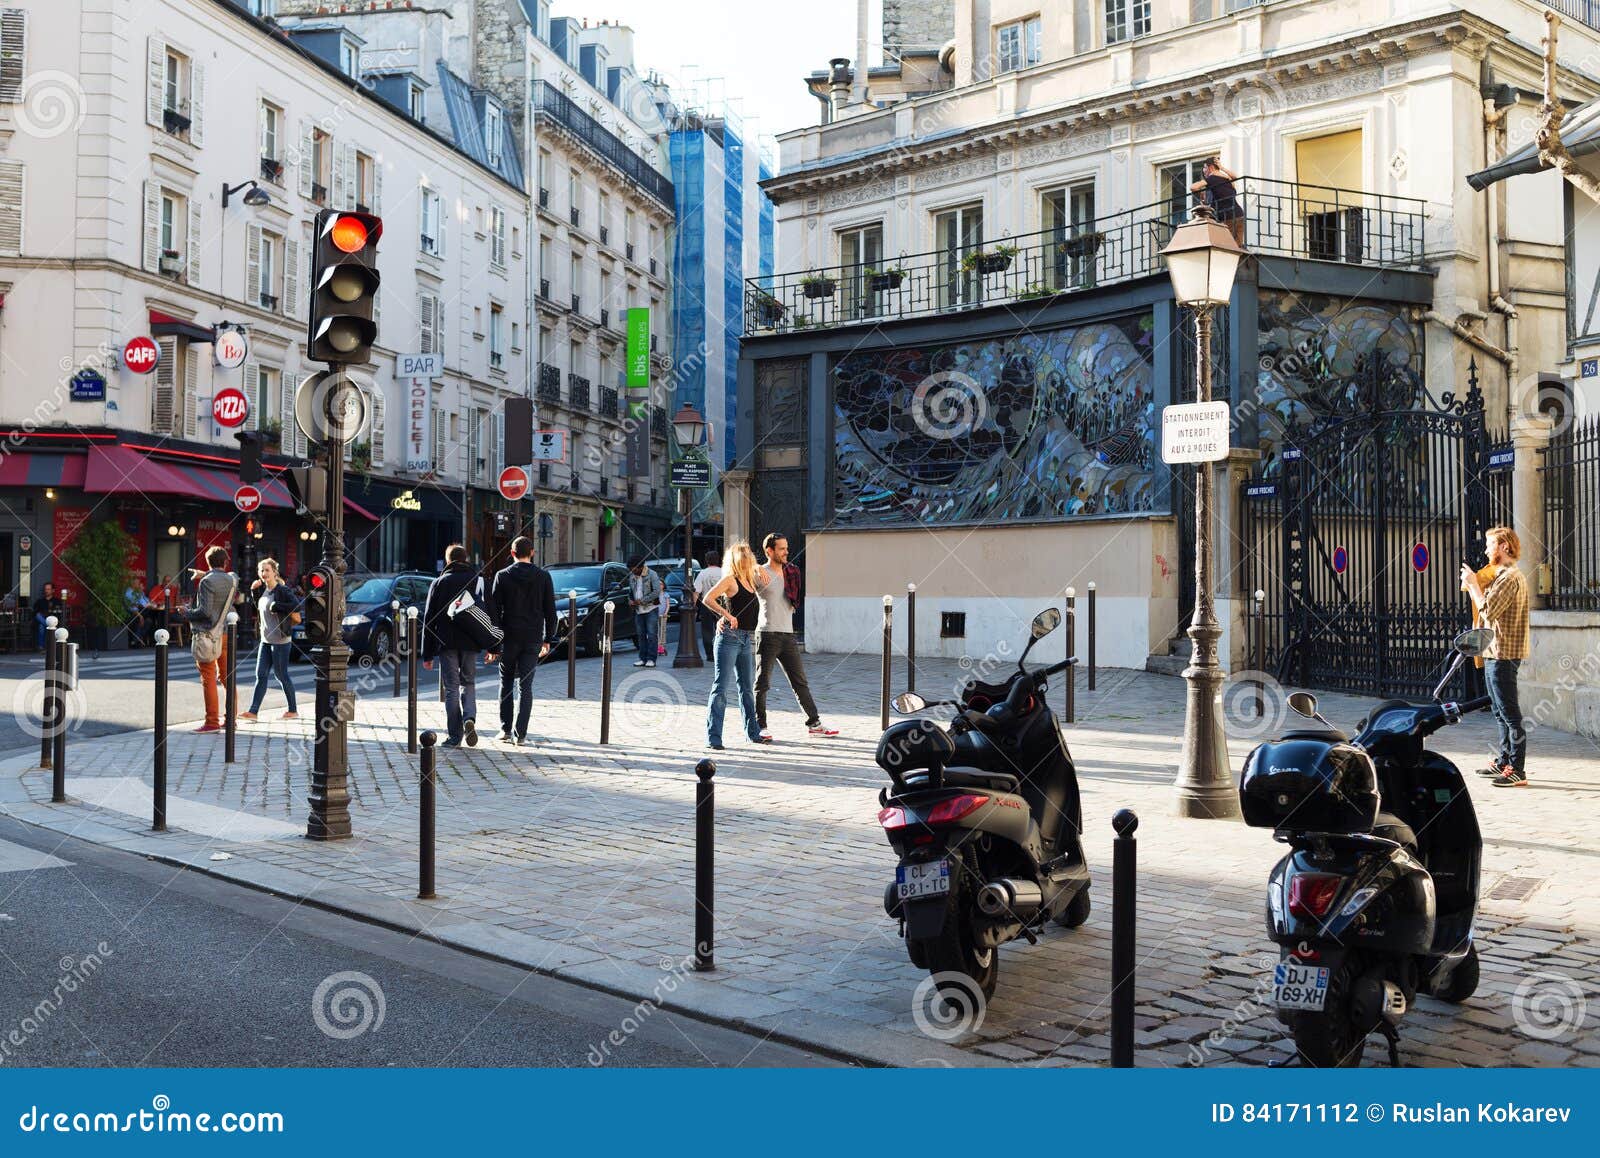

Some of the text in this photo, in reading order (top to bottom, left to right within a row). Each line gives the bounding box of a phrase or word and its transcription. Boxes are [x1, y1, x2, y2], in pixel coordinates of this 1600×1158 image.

[125, 347, 156, 364] CAFE
[404, 357, 435, 374] BAR
[633, 354, 647, 376] ibis
[1583, 362, 1596, 375] 26
[213, 395, 246, 419] PIZZA
[1164, 411, 1225, 424] STATIONNEMENT
[1178, 427, 1211, 438] INTERDIT
[1171, 445, 1185, 454] AUX
[407, 460, 429, 471] BAR
[911, 866, 927, 879] CL
[901, 877, 947, 897] 681-TC
[1275, 986, 1324, 1004] 169-XH
